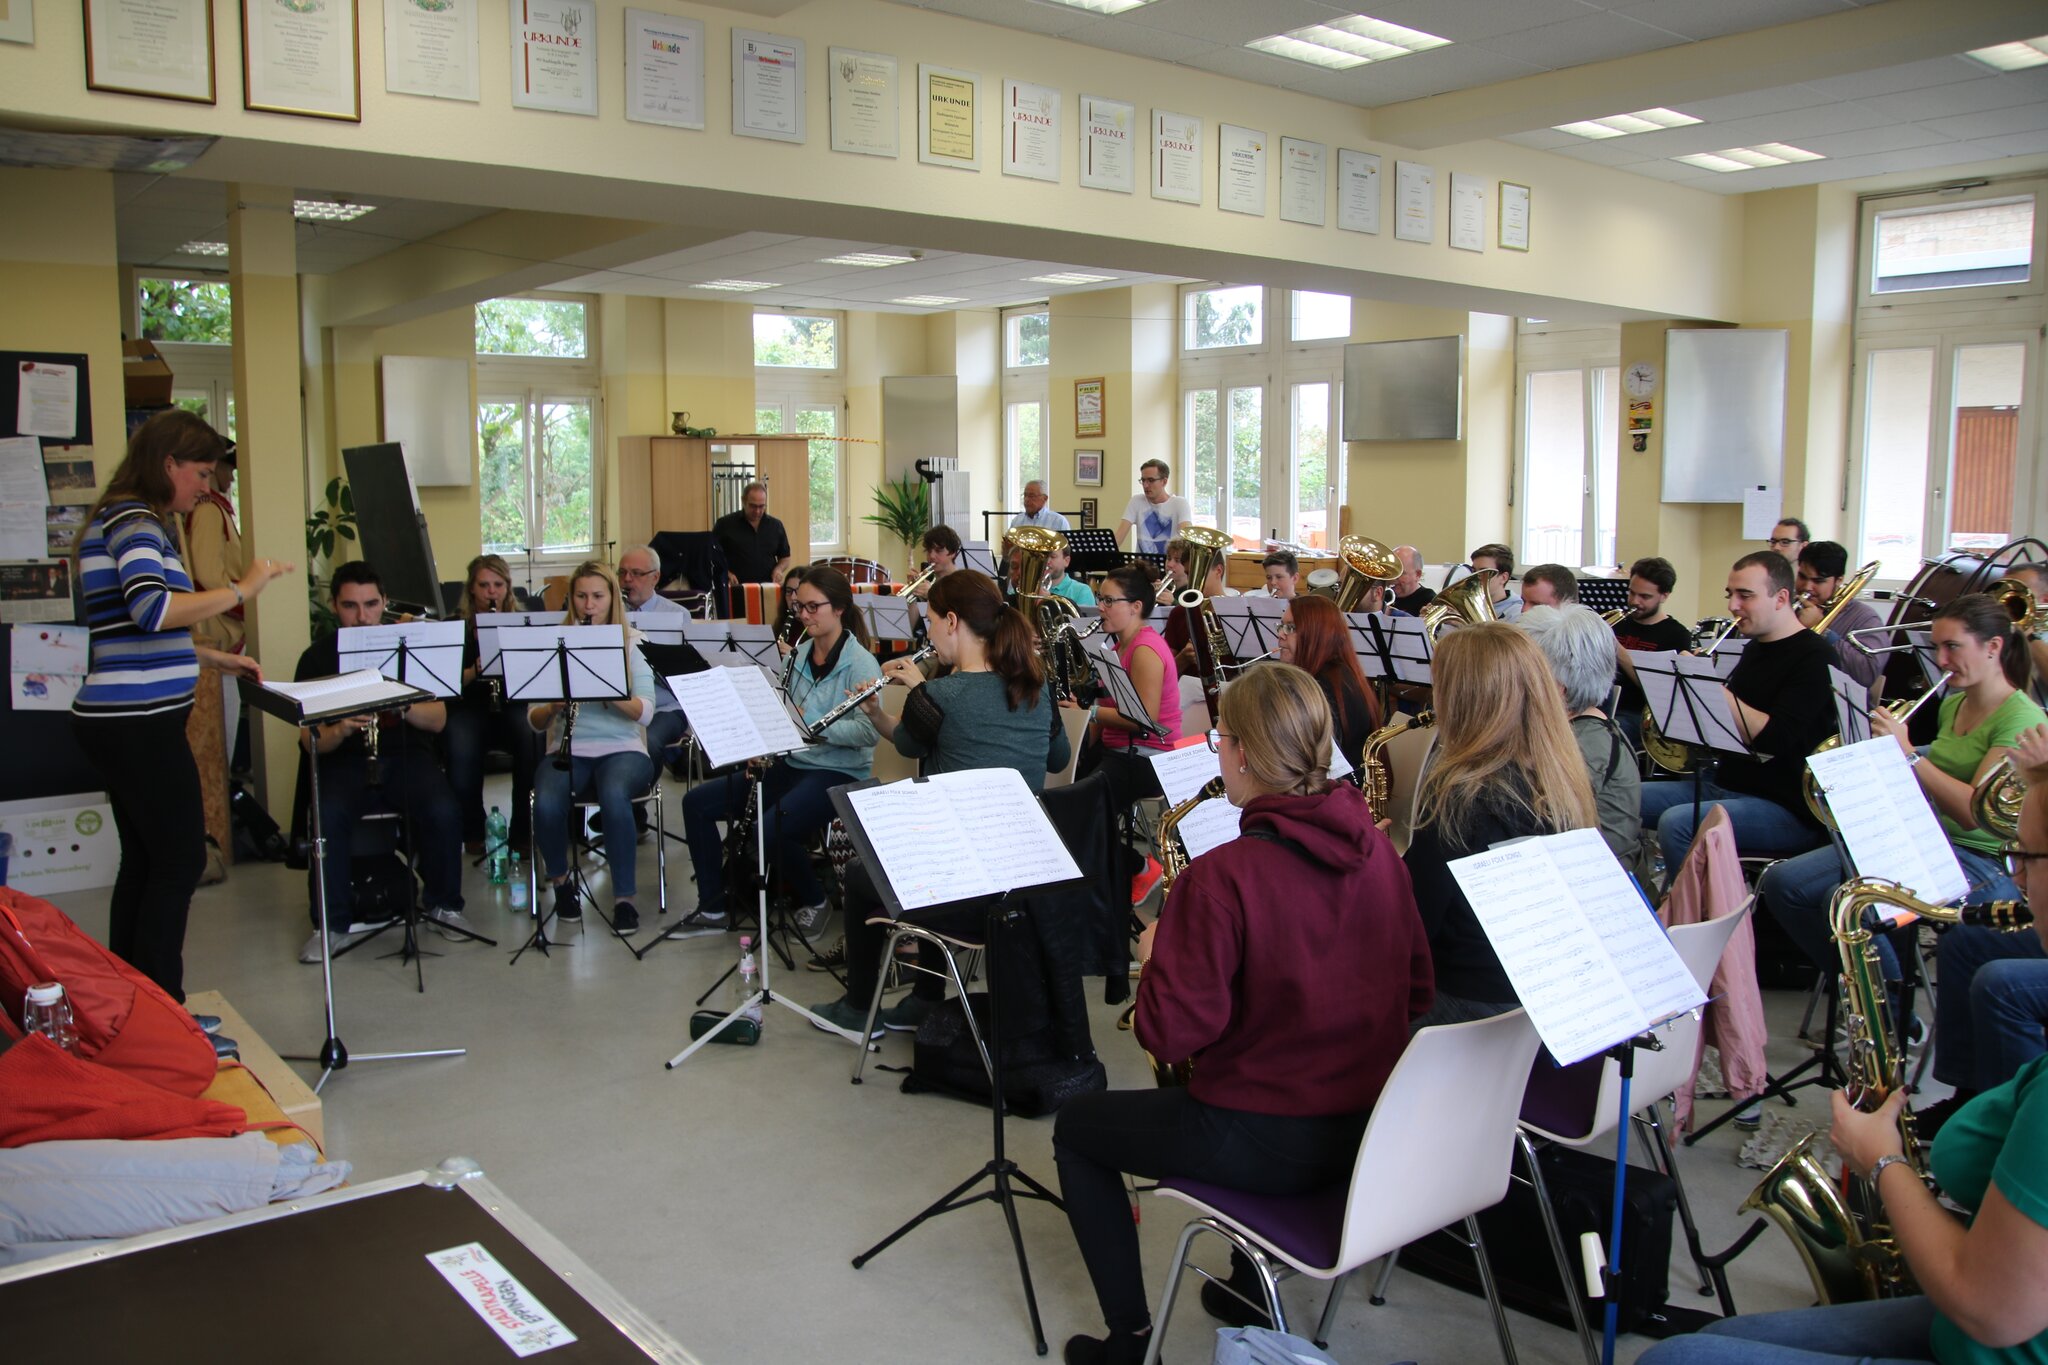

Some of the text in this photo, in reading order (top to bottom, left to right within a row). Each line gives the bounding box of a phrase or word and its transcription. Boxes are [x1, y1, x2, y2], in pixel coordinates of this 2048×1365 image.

[523, 31, 582, 48] URKUNDE
[652, 39, 681, 54] Urkunde
[932, 94, 970, 107] URKUNDE
[1012, 112, 1053, 126] URKUNDE
[1089, 126, 1126, 140] URKUNDE
[459, 1269, 525, 1330] STADTKAPELLE
[496, 1279, 544, 1324] EPPINGEN
